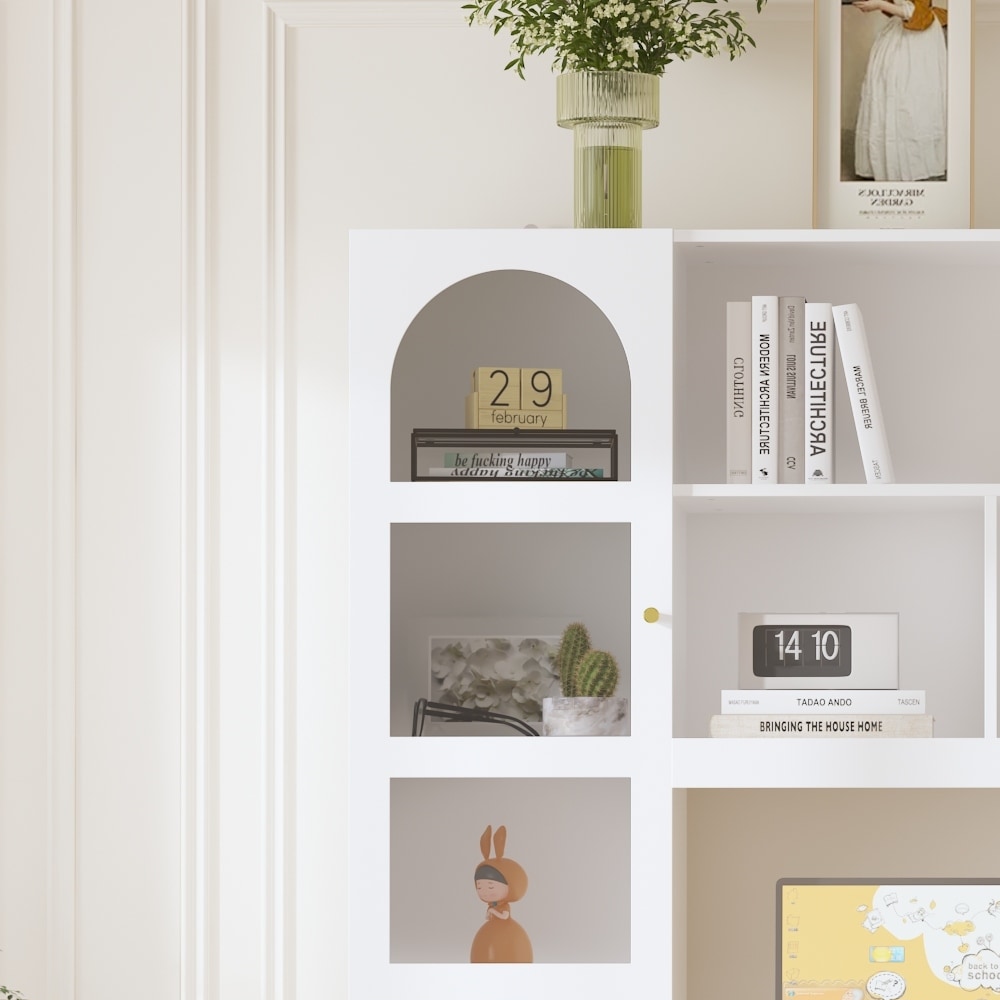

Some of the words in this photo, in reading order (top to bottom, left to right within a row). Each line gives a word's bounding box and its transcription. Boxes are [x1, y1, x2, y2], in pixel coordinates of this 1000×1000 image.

[490, 410, 548, 427] february
[454, 453, 468, 467] be
[470, 452, 514, 470] fucking
[517, 452, 552, 468] happy
[774, 630, 802, 661] 14
[811, 630, 839, 661] 10
[796, 698, 826, 706] TADAO
[828, 698, 852, 706] ANDO
[760, 721, 803, 732] BRINGING
[806, 721, 823, 732] THE
[825, 721, 855, 732] HOUSE
[858, 721, 883, 732] HOME
[968, 962, 988, 970] back
[990, 962, 999, 970] to
